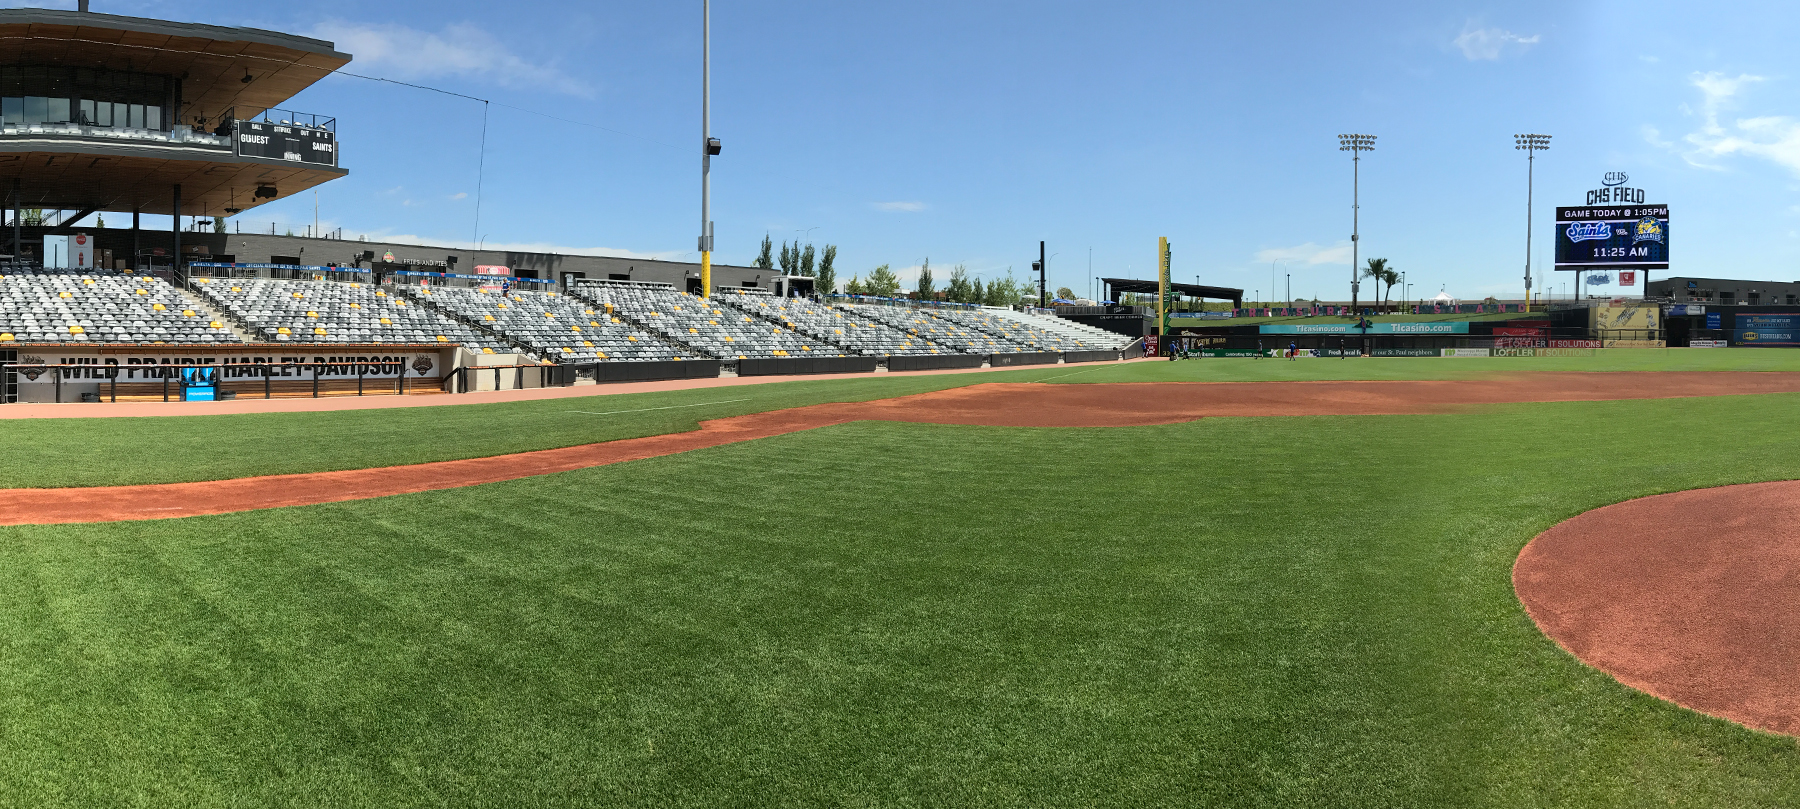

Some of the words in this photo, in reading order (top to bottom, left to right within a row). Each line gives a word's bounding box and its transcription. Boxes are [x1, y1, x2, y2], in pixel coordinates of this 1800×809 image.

[312, 142, 332, 152] SAINTS
[1586, 188, 1610, 206] CHS
[1614, 187, 1645, 204] FIELD
[1566, 222, 1612, 242] Saints
[1594, 248, 1626, 257] 11:25
[1629, 247, 1648, 256] AM
[1232, 306, 1348, 318] TREASURE
[1416, 304, 1526, 314] ISLAND
[1494, 349, 1534, 358] LOFFLER
[60, 358, 119, 378] WILD
[224, 356, 406, 378] HARLEY-DAVIDSON
